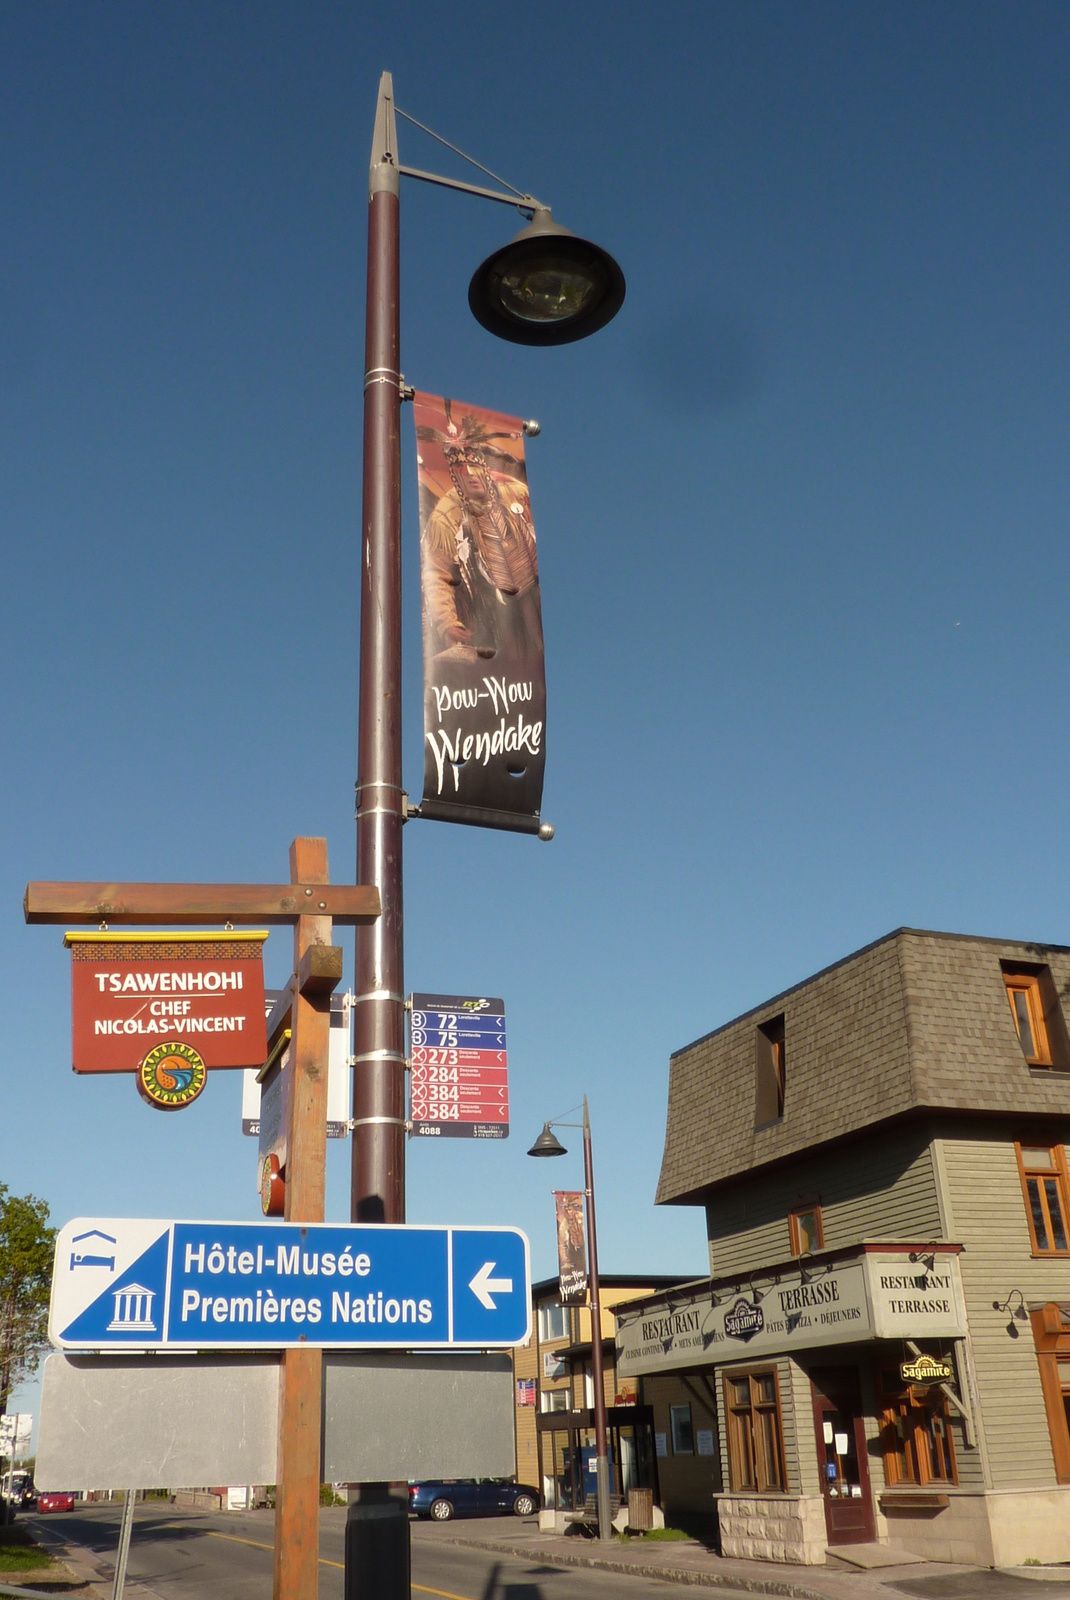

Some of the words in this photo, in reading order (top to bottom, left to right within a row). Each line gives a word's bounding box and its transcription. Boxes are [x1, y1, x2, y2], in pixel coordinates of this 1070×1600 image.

[425, 714, 543, 795] Wendake
[94, 971, 243, 992] TSAWENHOHI
[150, 1000, 191, 1016] CHEF
[94, 1016, 246, 1035] NICOLAS-VINCENT
[438, 1014, 458, 1029] 72
[438, 1031, 458, 1047] 75
[428, 1048, 458, 1065] 273
[428, 1066, 459, 1083] 284
[428, 1084, 460, 1101] 384
[429, 1103, 460, 1120] 584
[419, 1127, 441, 1135] 4088
[184, 1243, 372, 1277] Hôtel-Musée
[778, 1280, 840, 1311] TERRASSE
[181, 1289, 322, 1324] Premières
[332, 1291, 433, 1324] Nations
[889, 1299, 950, 1313] TERRASSE
[642, 1311, 700, 1341] RESTAURANT
